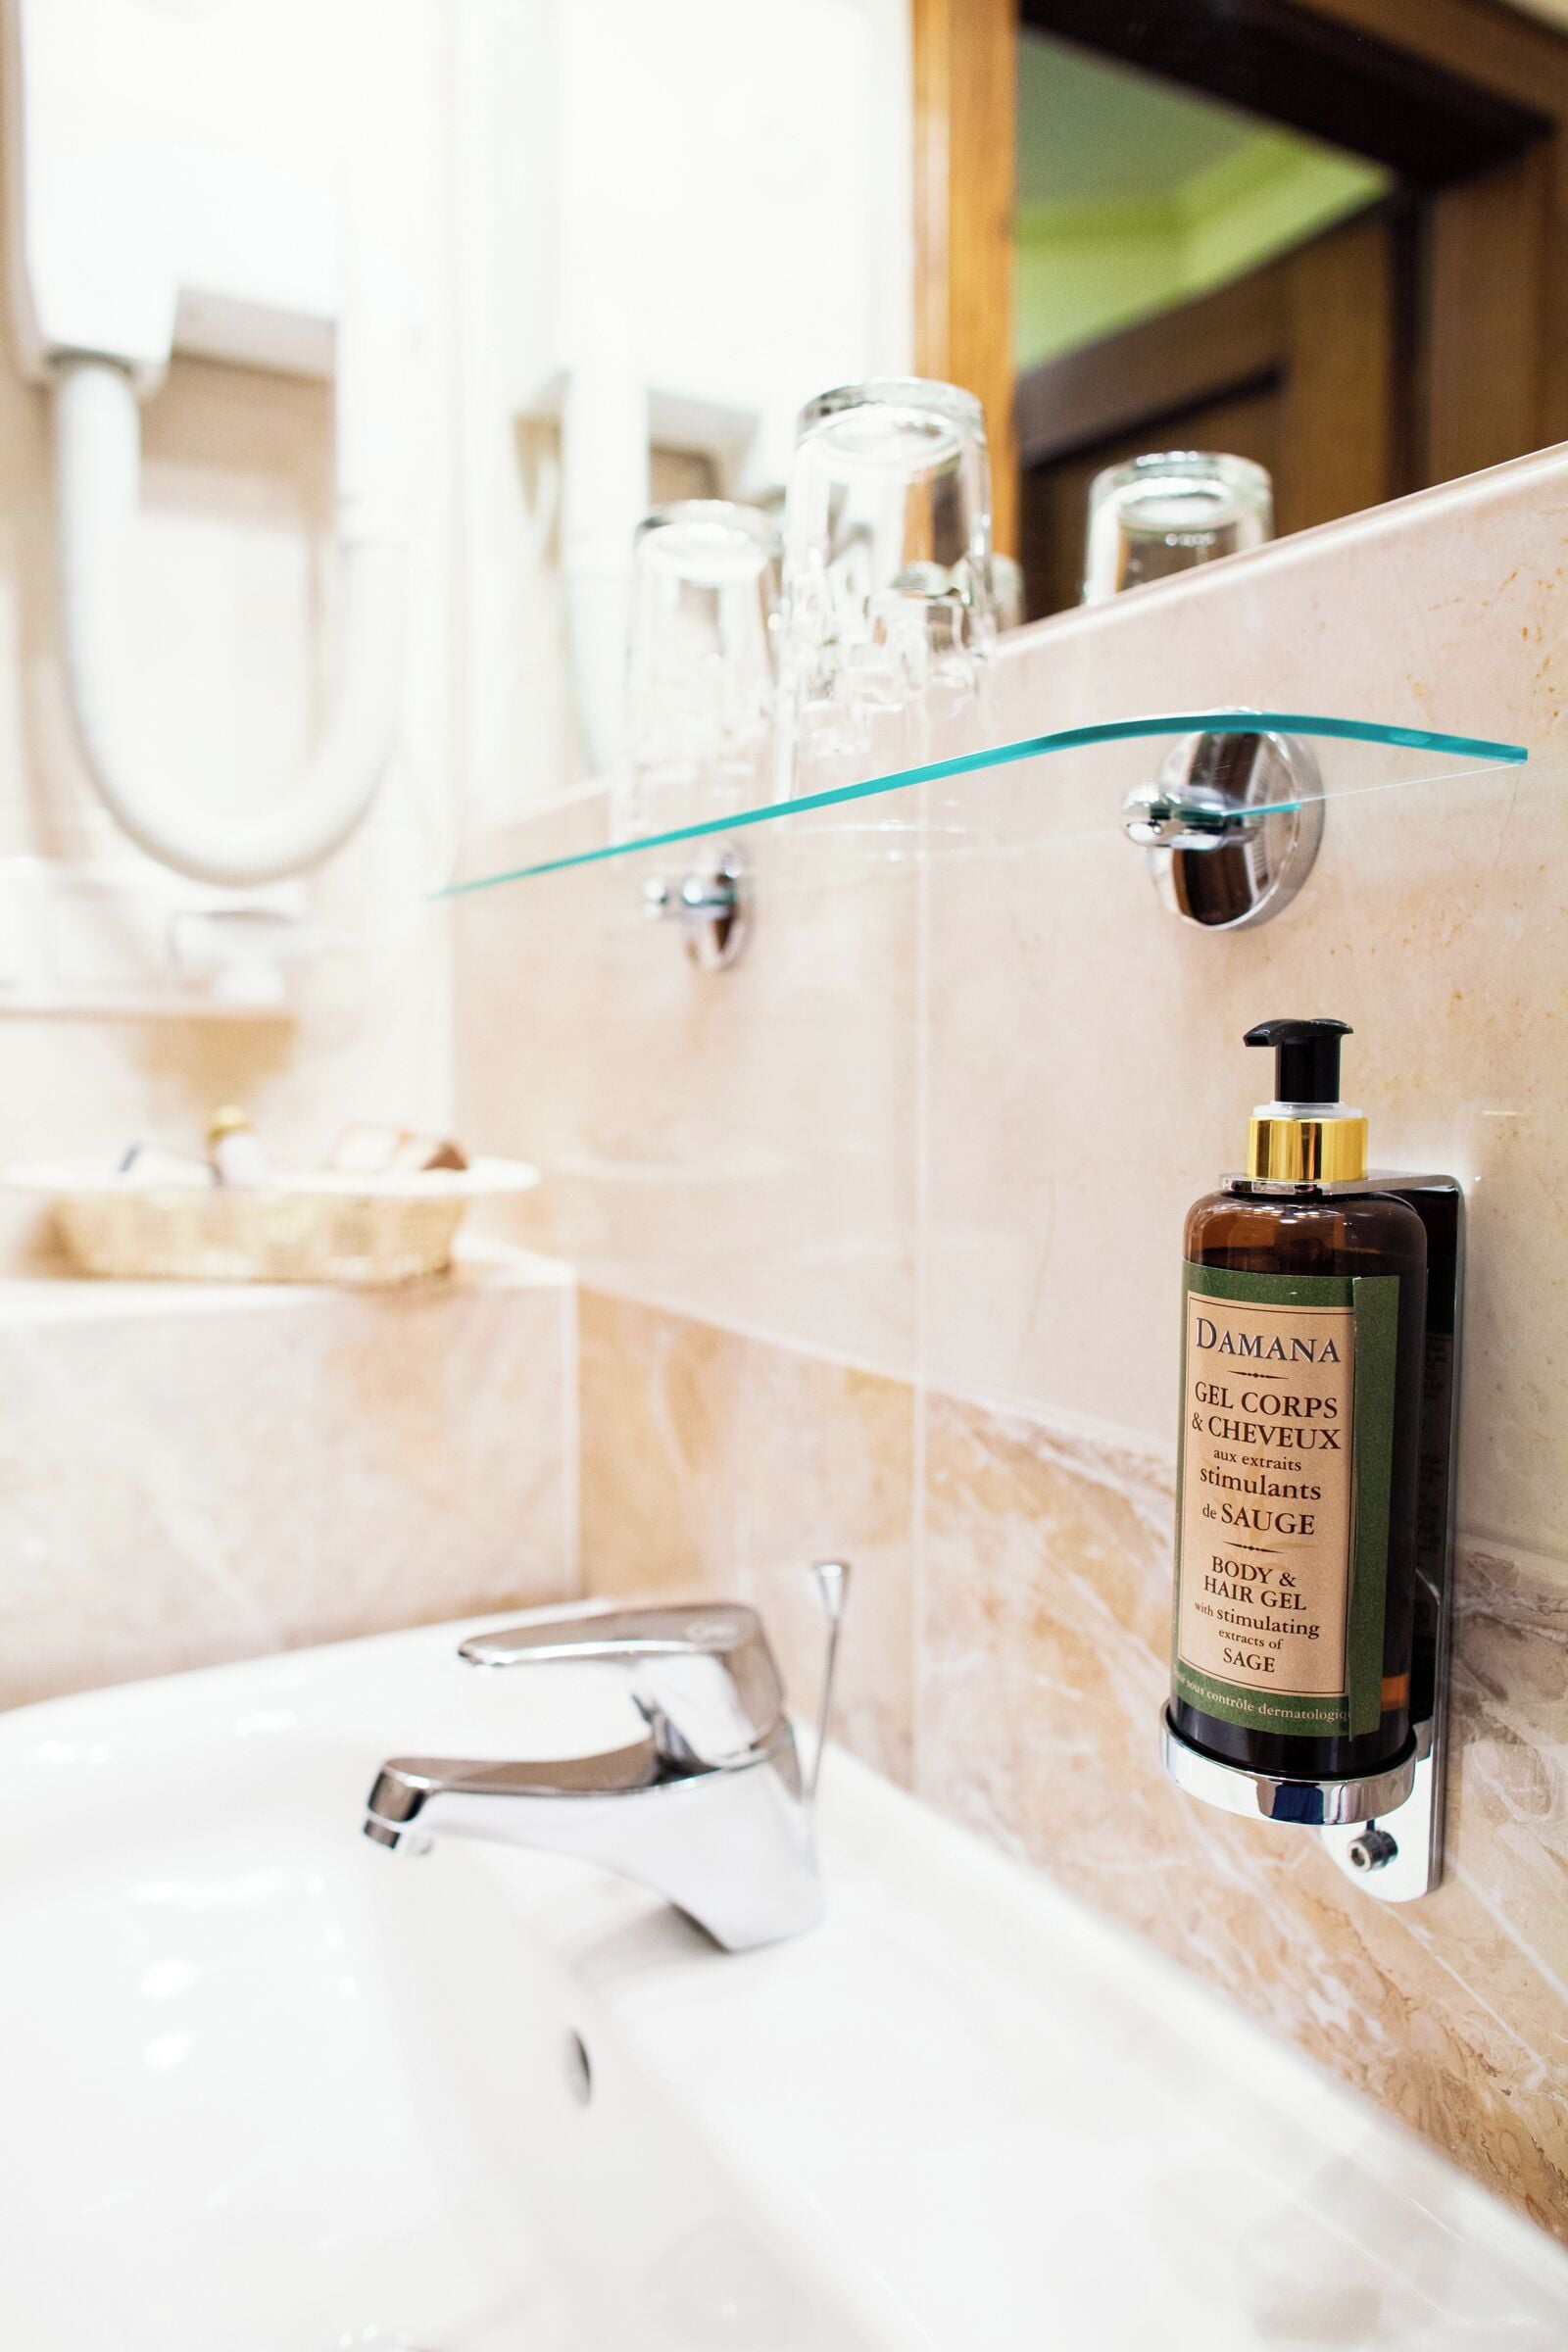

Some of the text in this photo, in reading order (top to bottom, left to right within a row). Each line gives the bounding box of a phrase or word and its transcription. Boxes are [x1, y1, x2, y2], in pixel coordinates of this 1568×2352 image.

[1196, 1317, 1341, 1363] DAMANA
[1195, 1381, 1338, 1419] GEL CORPS
[1192, 1411, 1342, 1449] & CHEVEUX
[1213, 1449, 1302, 1471] aux extraits
[1200, 1466, 1321, 1500] stimulants
[1202, 1502, 1315, 1535] de SAUGE
[1211, 1555, 1297, 1588] BODY &
[1203, 1575, 1307, 1610] HAIR GEL
[1195, 1602, 1320, 1640] with stimulating
[1218, 1629, 1284, 1650] extracts of
[1223, 1647, 1275, 1673] SAGE
[1206, 1690, 1254, 1712] contrôle
[1257, 1702, 1349, 1723] dermatologiq
